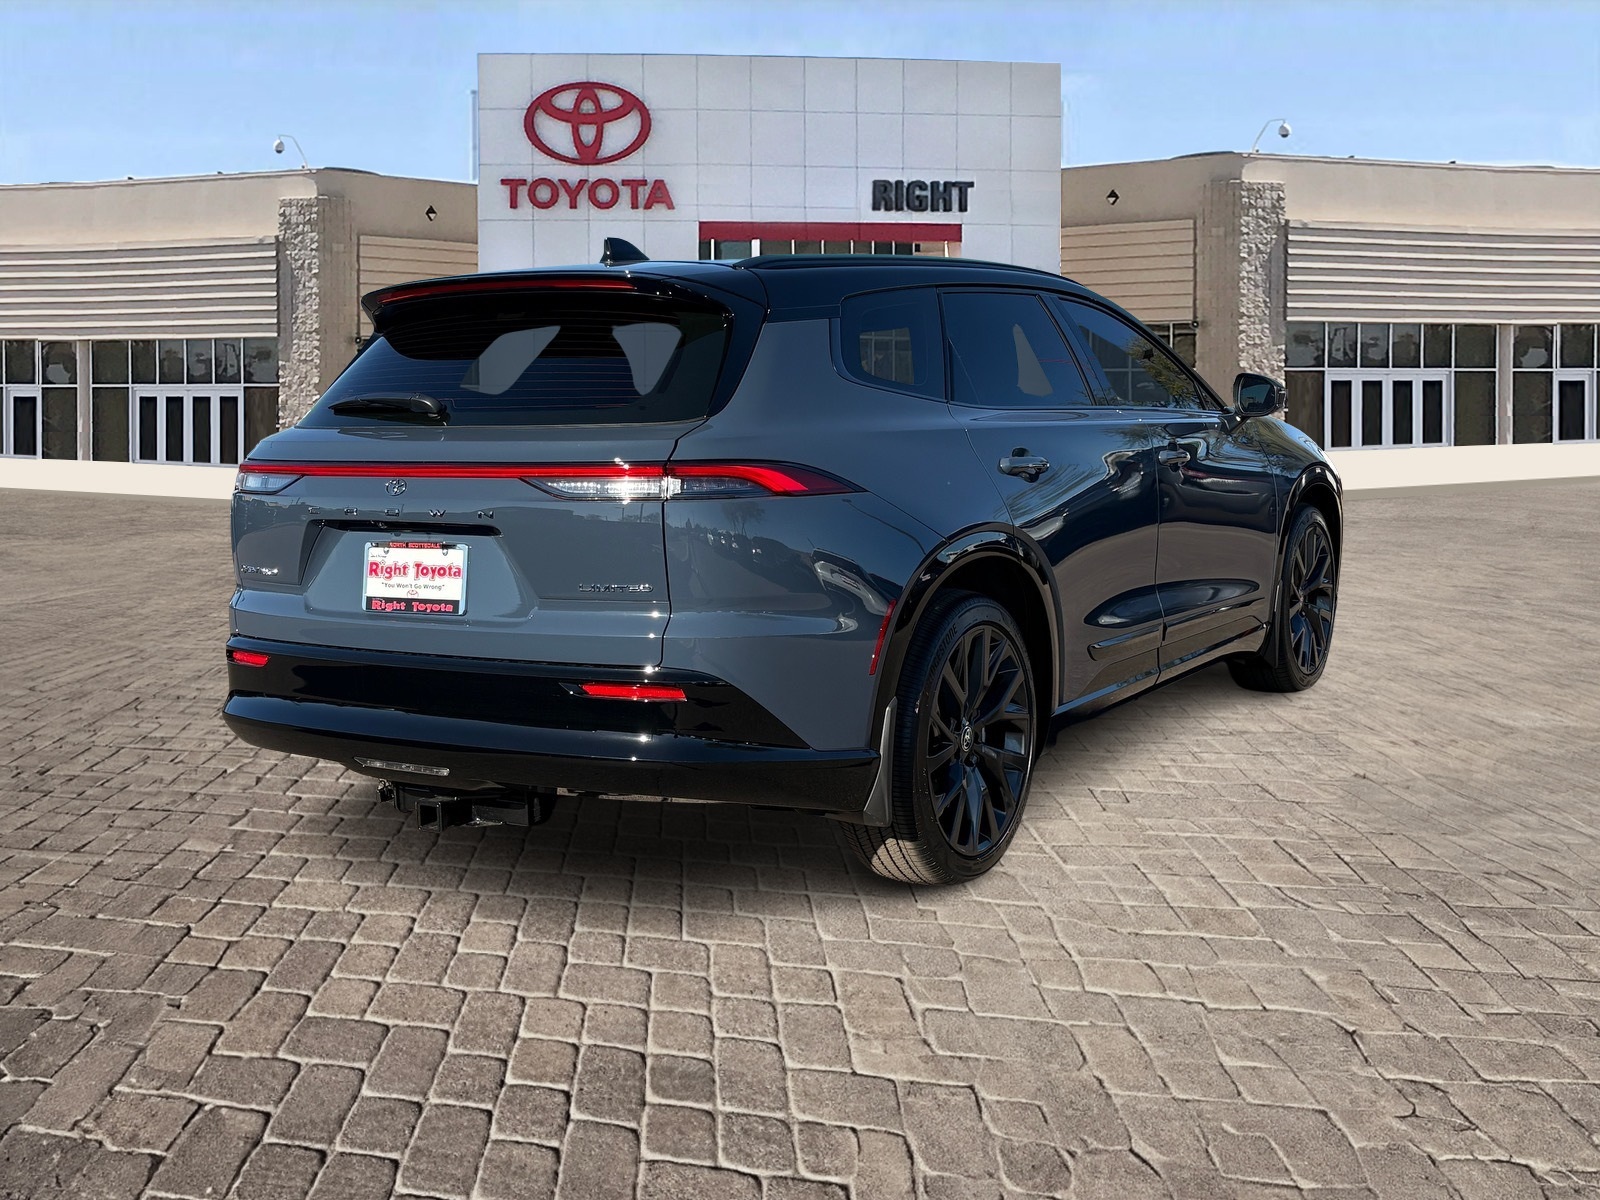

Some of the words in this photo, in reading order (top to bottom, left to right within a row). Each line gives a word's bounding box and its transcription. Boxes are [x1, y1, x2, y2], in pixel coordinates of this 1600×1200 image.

[500, 178, 676, 211] TOYOTA
[871, 179, 975, 213] RIGHT
[308, 506, 495, 520] CROWN
[368, 561, 409, 580] Right
[414, 561, 463, 581] Toyota
[578, 583, 655, 593] LIMITED
[371, 599, 406, 612] Right
[412, 602, 454, 613] Toyota
[924, 622, 959, 690] IDGESTONE
